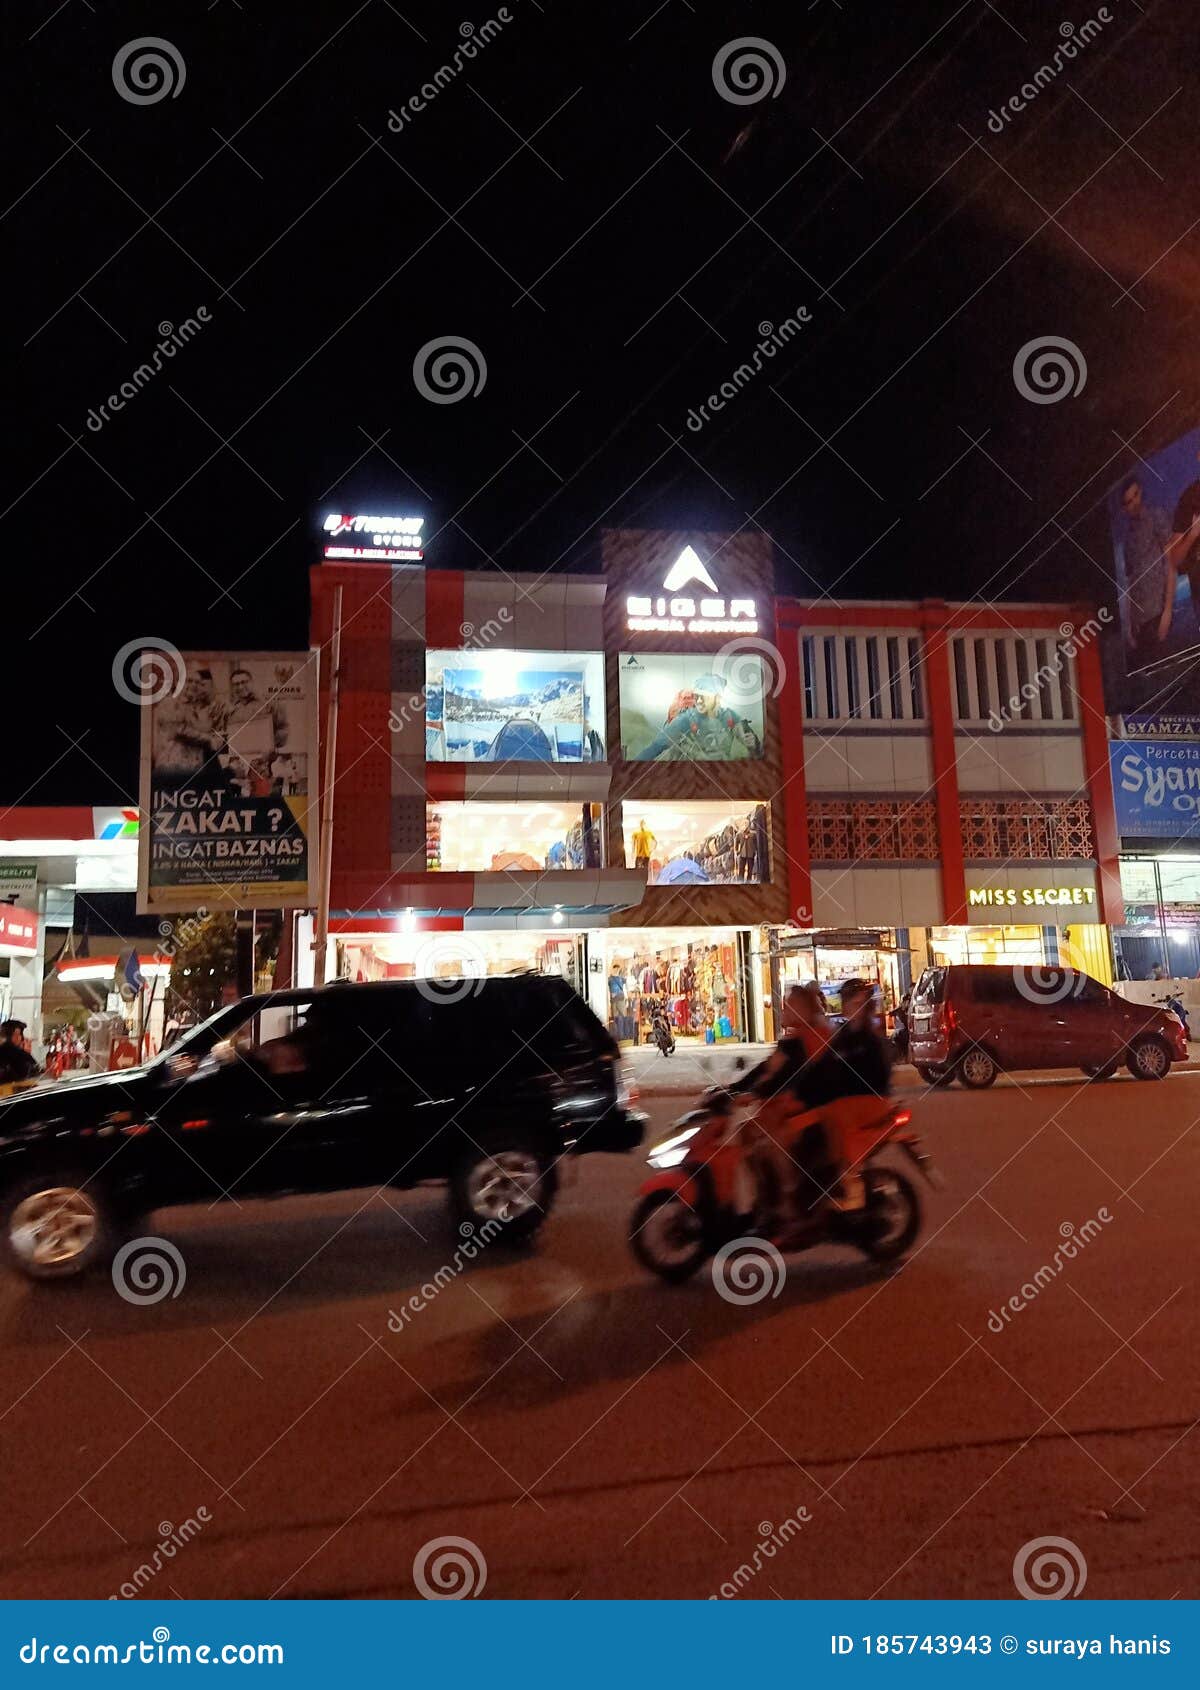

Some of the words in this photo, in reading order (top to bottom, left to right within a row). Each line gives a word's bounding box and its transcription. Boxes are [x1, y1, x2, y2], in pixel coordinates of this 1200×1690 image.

[1127, 723, 1194, 734] SYAMZA
[153, 789, 226, 809] INGAT
[149, 809, 257, 835] ZAKAT
[969, 888, 1016, 906] MISS
[1022, 887, 1096, 906] SECRET
